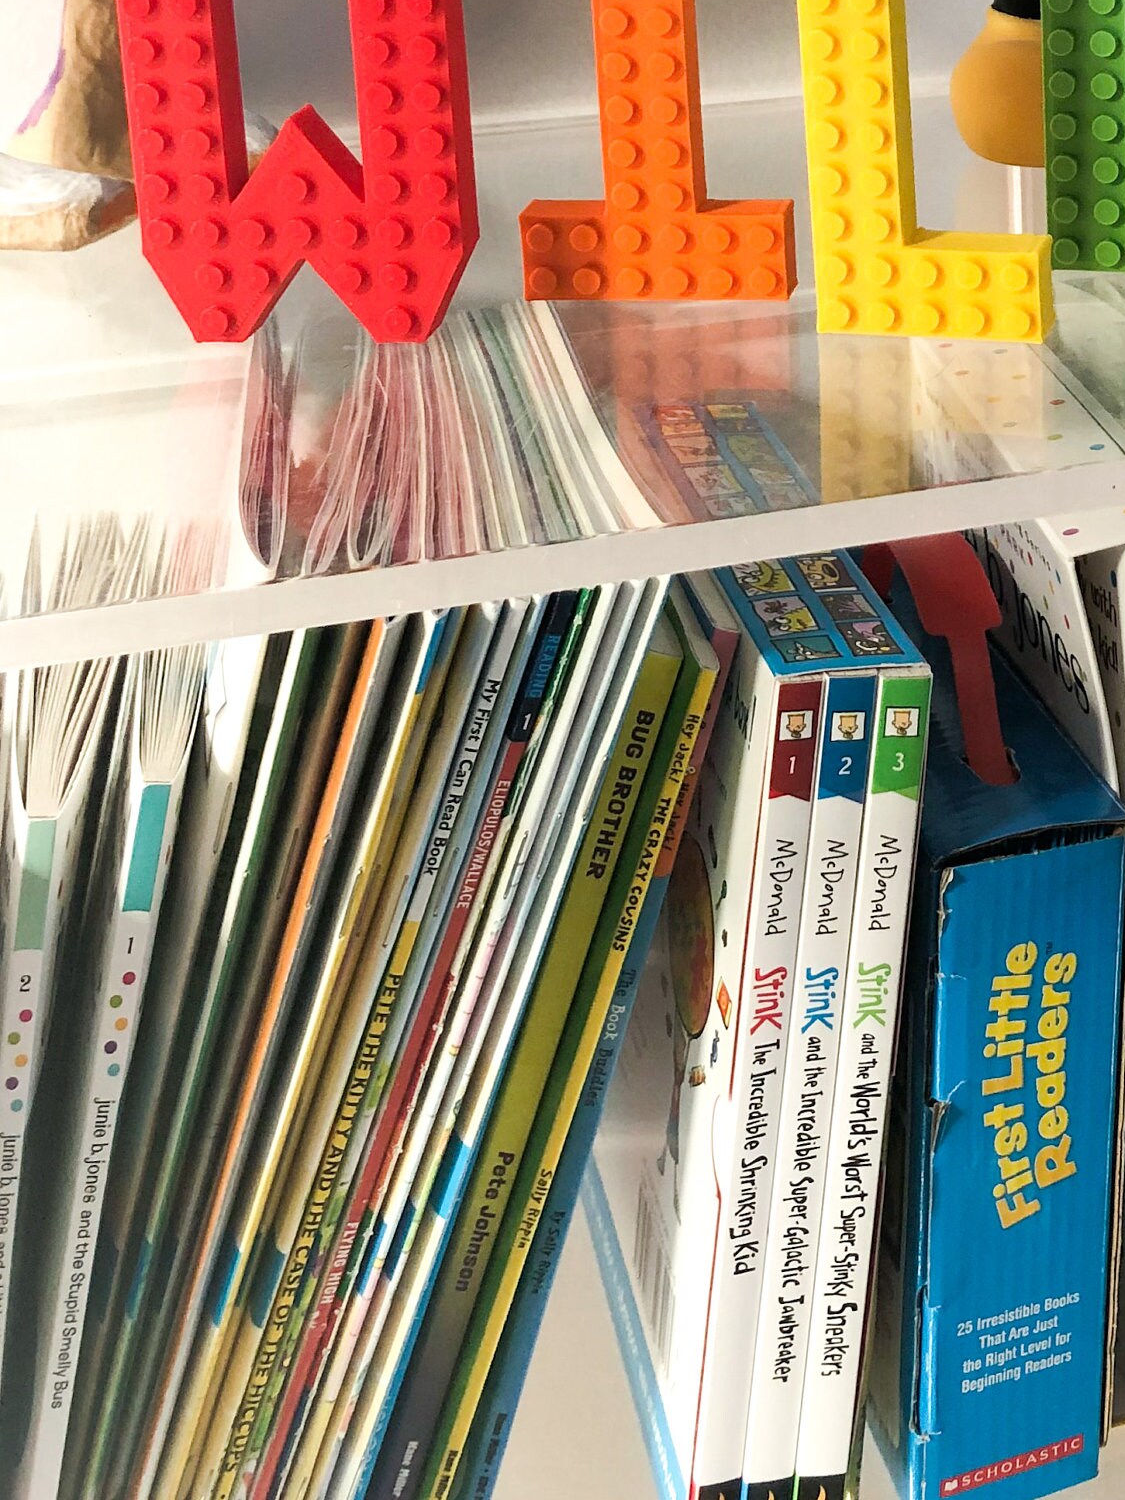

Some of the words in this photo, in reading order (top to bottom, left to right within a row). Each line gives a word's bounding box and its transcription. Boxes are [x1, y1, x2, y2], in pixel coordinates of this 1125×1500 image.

[526, 634, 561, 699] READING
[486, 677, 501, 702] My
[468, 705, 491, 743] First
[630, 709, 656, 759] BUG
[682, 714, 701, 740] Hey
[449, 758, 474, 791] Can
[668, 742, 690, 784] Jack!
[788, 755, 797, 775] 1
[837, 756, 853, 776] 2
[891, 752, 905, 772] 3
[439, 792, 462, 833] Read
[585, 765, 638, 881] BROTHER
[650, 797, 671, 826] THE
[423, 833, 448, 877] Book
[455, 779, 512, 910] ELIOPULOS/WALLACE
[635, 829, 662, 882] CRAZY
[764, 839, 798, 936] McDonald
[814, 839, 849, 936] McDonald
[867, 834, 903, 931] McDonald
[612, 885, 643, 952] COUSINS
[126, 936, 136, 955] 1
[19, 974, 33, 993] 2
[370, 973, 401, 1025] PETE
[614, 968, 637, 997] The
[749, 965, 788, 1036] Stink
[800, 965, 840, 1035] Stink
[852, 961, 892, 1030] Stink
[603, 1003, 626, 1041] Book
[981, 940, 1039, 1097] Little
[360, 1033, 382, 1073] THE
[752, 1038, 781, 1067] The
[804, 1036, 827, 1063] and
[860, 1033, 880, 1056] and
[803, 1066, 828, 1089] the
[857, 1057, 878, 1080] the
[1026, 951, 1078, 1190] Readers
[93, 1096, 117, 1139] junie
[335, 1083, 367, 1137] KITTY
[743, 1068, 778, 1151] Incredible
[792, 1090, 825, 1173] Incredible
[847, 1081, 883, 1151] World's
[0, 1131, 21, 1172] junie
[318, 1151, 343, 1192] AND
[982, 1102, 1042, 1230] First
[80, 1156, 101, 1203] jones
[483, 1150, 515, 1200] Pete
[529, 1168, 553, 1205] Sally
[729, 1154, 769, 1240] Shrinking
[840, 1151, 873, 1203] Worst
[76, 1210, 93, 1239] and
[301, 1201, 325, 1238] THE
[517, 1205, 541, 1250] Rippin
[781, 1175, 815, 1289] Super-Galactic
[72, 1242, 89, 1270] the
[333, 1221, 360, 1268] FLYING
[454, 1204, 497, 1292] Johnson
[733, 1240, 760, 1276] Kid
[823, 1205, 866, 1297] Super-Stinky
[282, 1243, 309, 1296] CASE
[319, 1269, 344, 1305] HIGH
[63, 1272, 87, 1325] Stupid
[956, 1321, 973, 1337] 25
[976, 1301, 1041, 1331] Irresistible
[1044, 1291, 1081, 1312] Books
[50, 1326, 78, 1377] Smelly
[772, 1294, 806, 1384] Jawbreaker
[820, 1301, 859, 1377] Sneakers
[962, 1357, 982, 1374] the
[985, 1346, 1017, 1368] Right
[1020, 1336, 1051, 1358] Level
[1055, 1331, 1072, 1347] for
[979, 1331, 1006, 1349] That
[1008, 1325, 1030, 1341] Are
[1033, 1314, 1059, 1334] Just
[253, 1338, 278, 1381] THE
[961, 1365, 1022, 1394] Beginning
[1024, 1350, 1072, 1375] Readers
[50, 1379, 69, 1410] Bus
[224, 1388, 263, 1472] HICCUPS
[961, 1437, 1082, 1488] SCHOLASTIC
